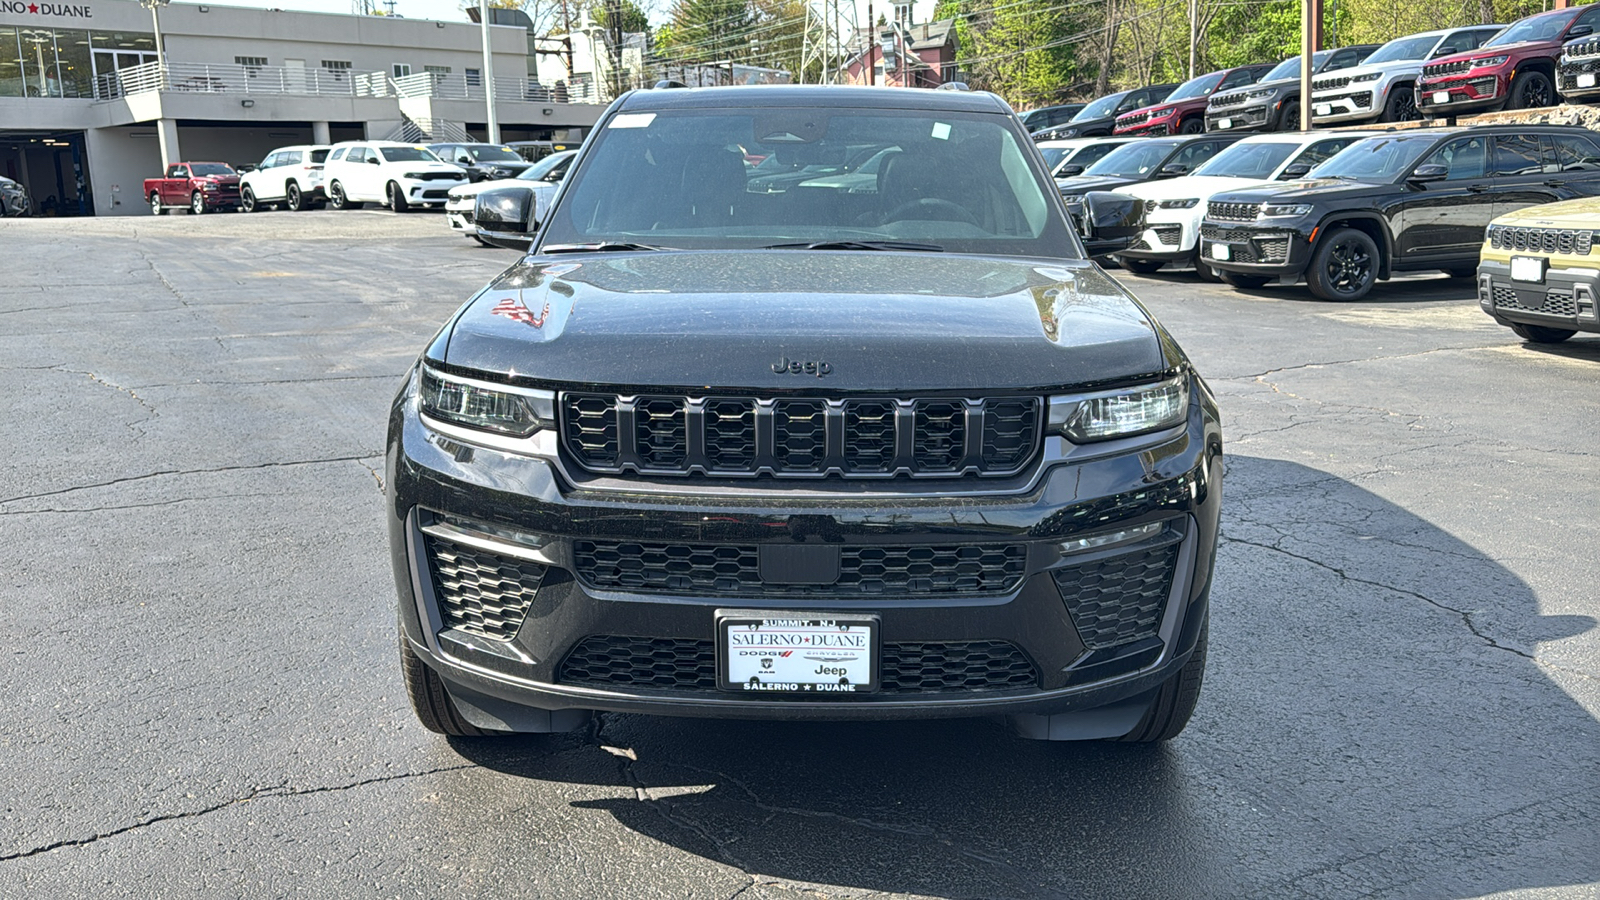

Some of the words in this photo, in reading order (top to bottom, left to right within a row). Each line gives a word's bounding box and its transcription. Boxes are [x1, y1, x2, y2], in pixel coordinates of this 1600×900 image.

[0, 1, 26, 14] NO
[40, 3, 93, 18] DUANE
[771, 357, 832, 377] Jeep
[732, 634, 802, 646] SALERNO
[811, 635, 865, 647] DUANE
[814, 665, 847, 676] Jeep
[743, 683, 799, 691] SALERNO
[816, 684, 856, 692] DUANE
